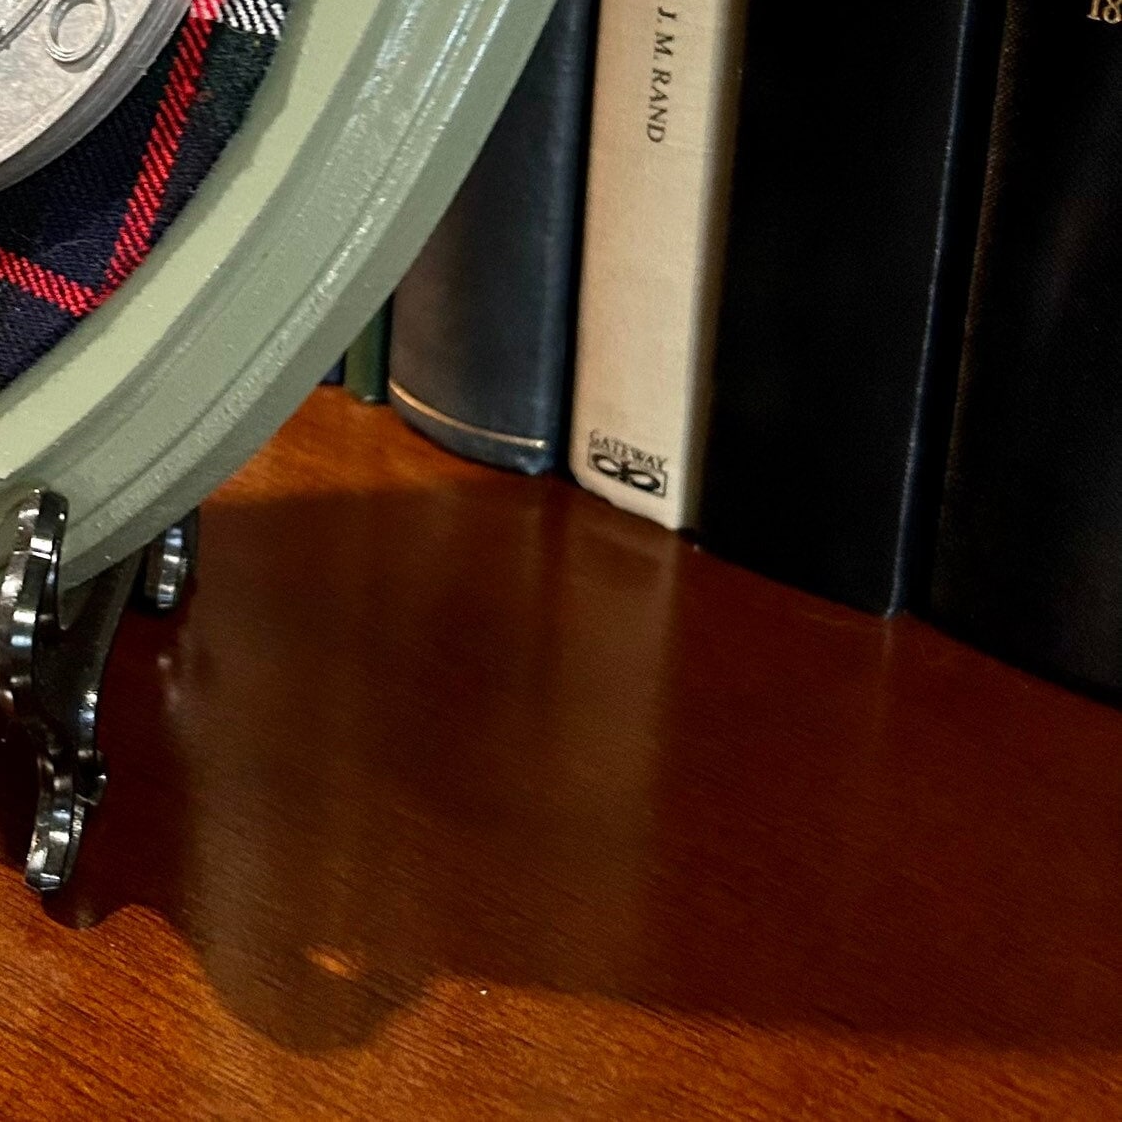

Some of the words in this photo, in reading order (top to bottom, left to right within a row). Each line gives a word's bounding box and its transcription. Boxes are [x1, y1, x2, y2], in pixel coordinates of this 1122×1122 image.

[656, 5, 678, 24] J.
[653, 31, 675, 61] M.
[646, 67, 672, 144] RAND
[588, 428, 668, 474] GATEWAY
